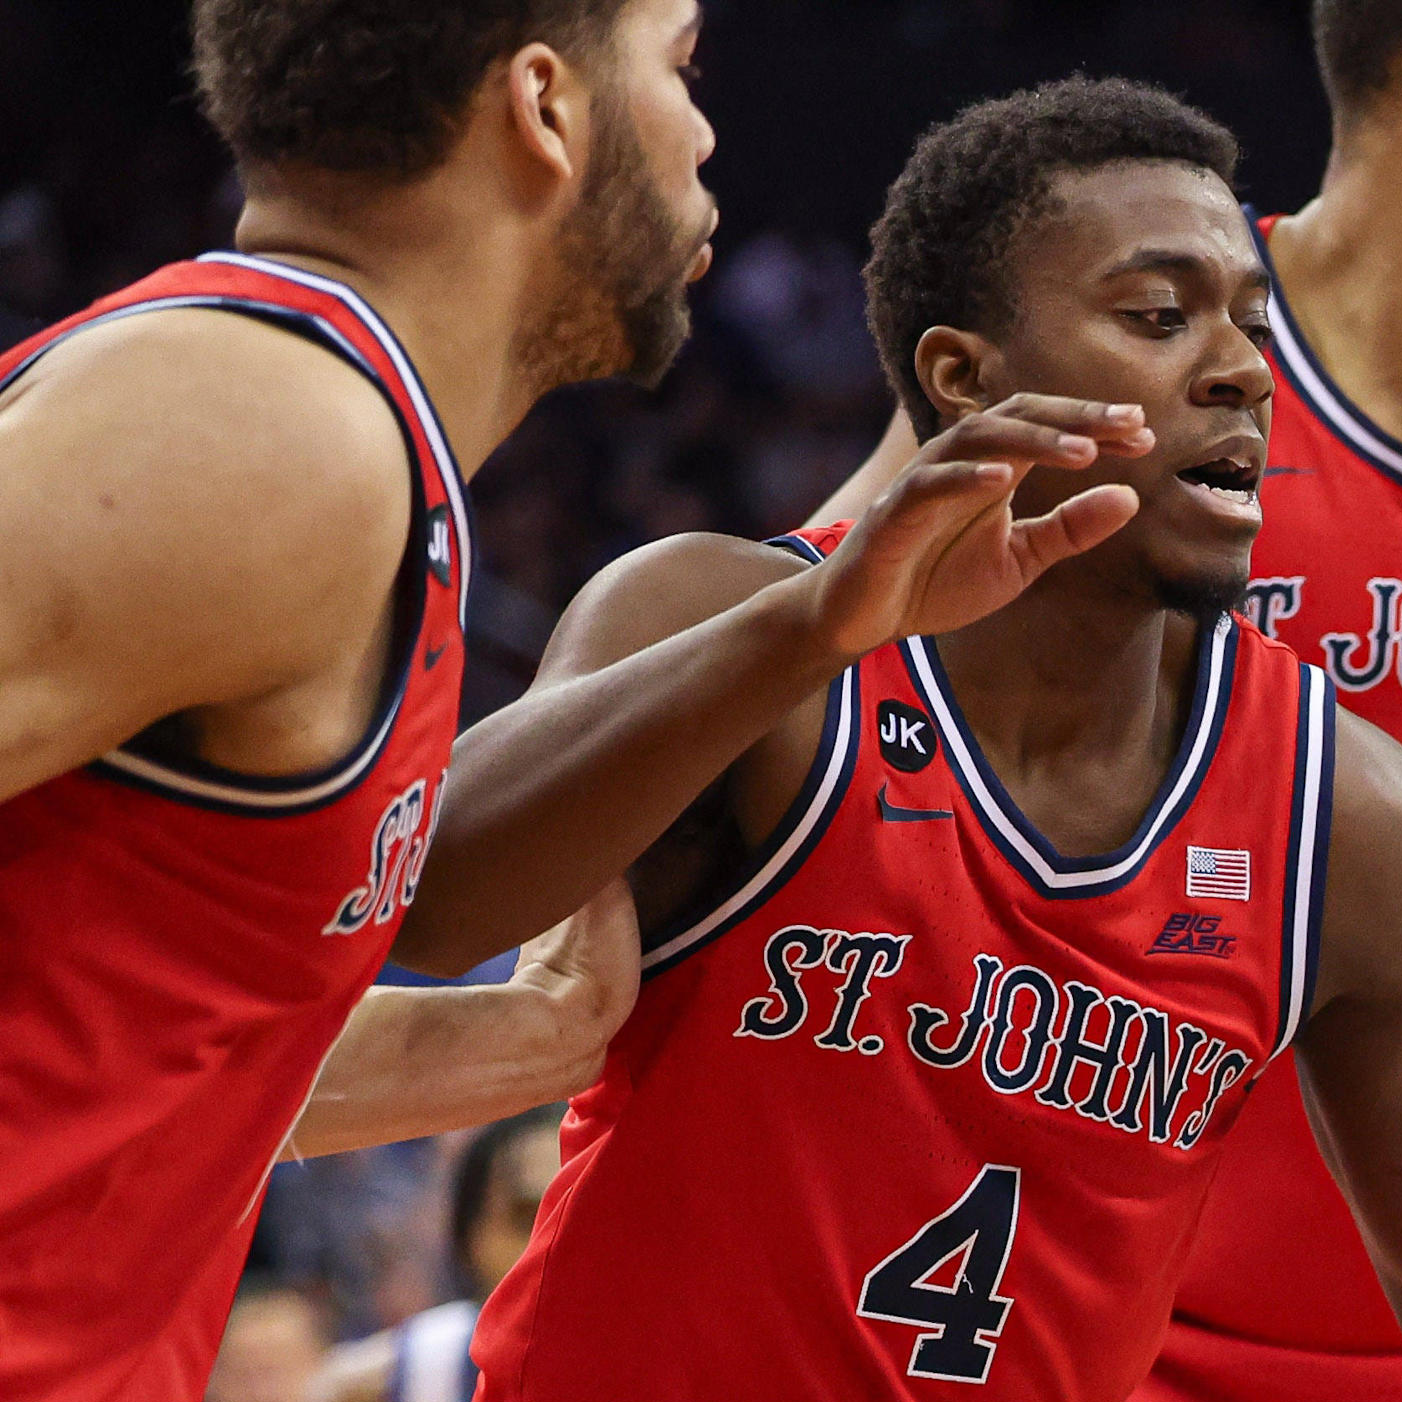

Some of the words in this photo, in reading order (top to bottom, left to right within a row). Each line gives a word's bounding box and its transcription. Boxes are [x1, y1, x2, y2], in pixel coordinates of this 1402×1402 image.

[880, 712, 927, 755] JK
[1153, 931, 1237, 952] EAST
[1165, 913, 1222, 932] BIG
[733, 924, 912, 1055] ST.
[908, 953, 1252, 1150] JOHN'S
[856, 1162, 1021, 1385] 4
